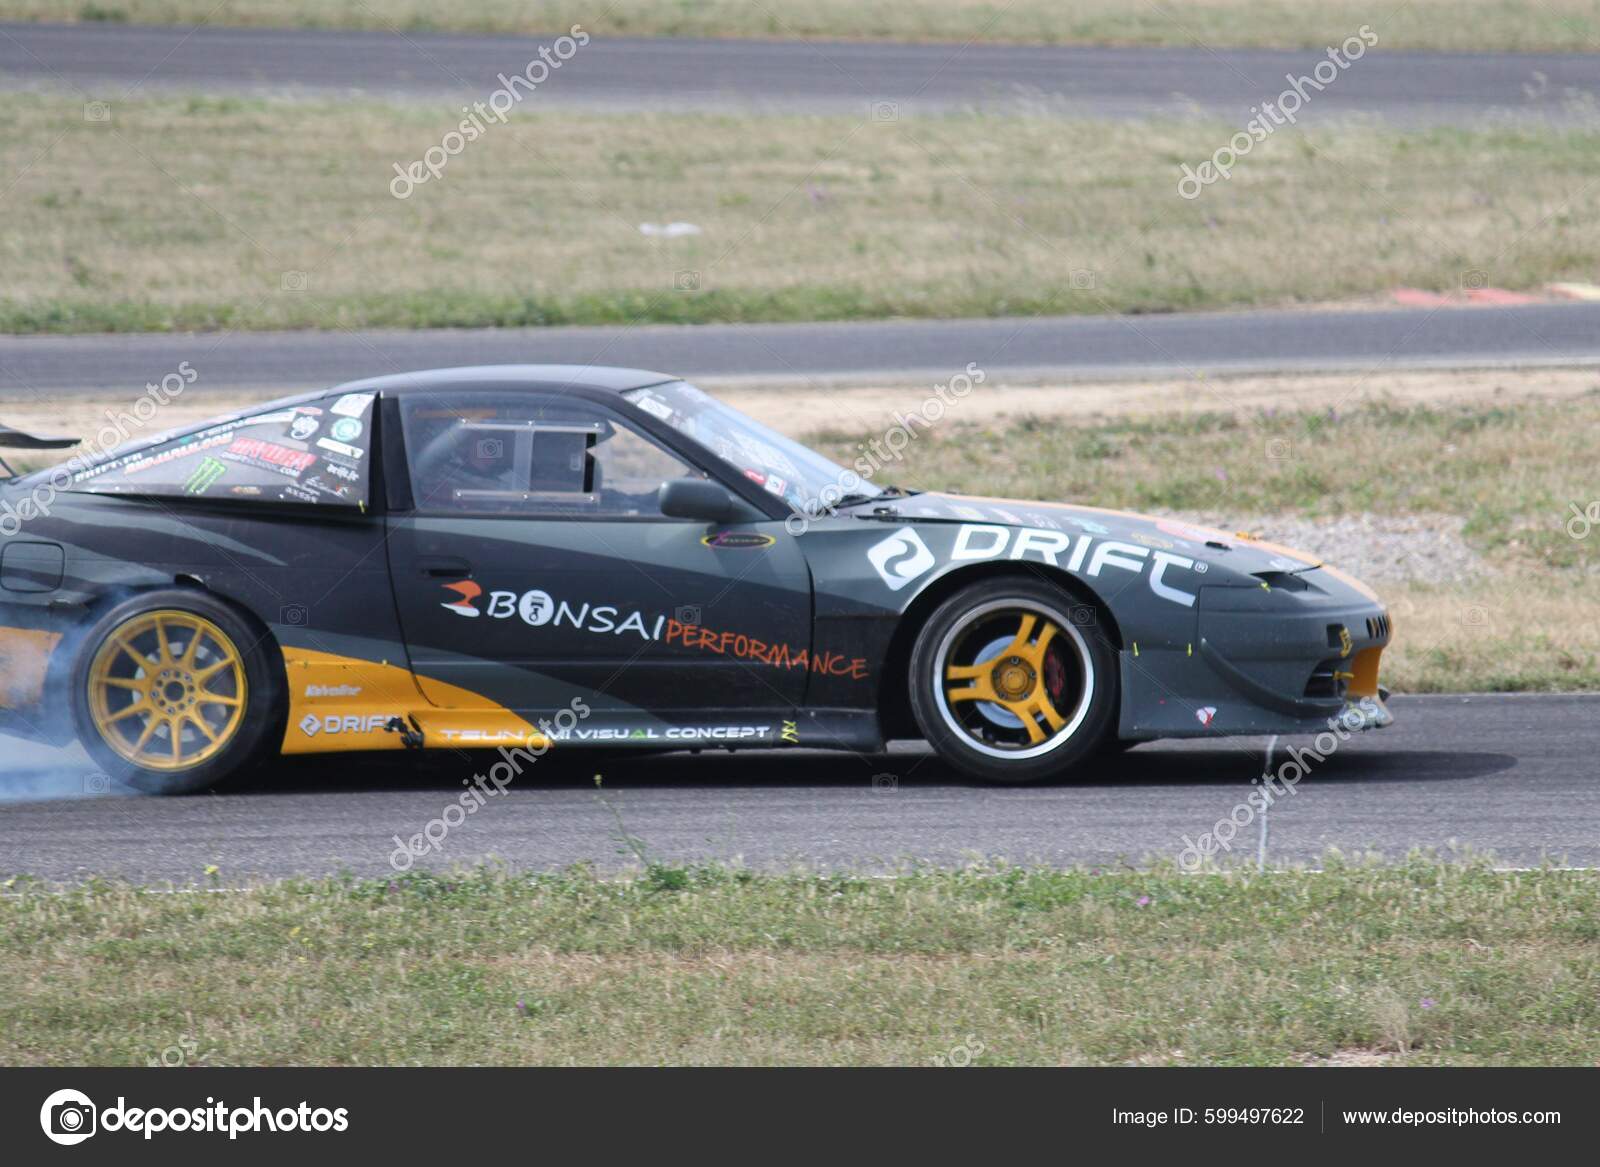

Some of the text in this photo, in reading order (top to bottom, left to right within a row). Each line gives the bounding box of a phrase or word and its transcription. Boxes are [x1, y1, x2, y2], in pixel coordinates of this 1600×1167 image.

[487, 590, 869, 680] BONSAI PERFORMANCE
[575, 728, 659, 740] VISUAL
[665, 726, 770, 739] CONCEPT
